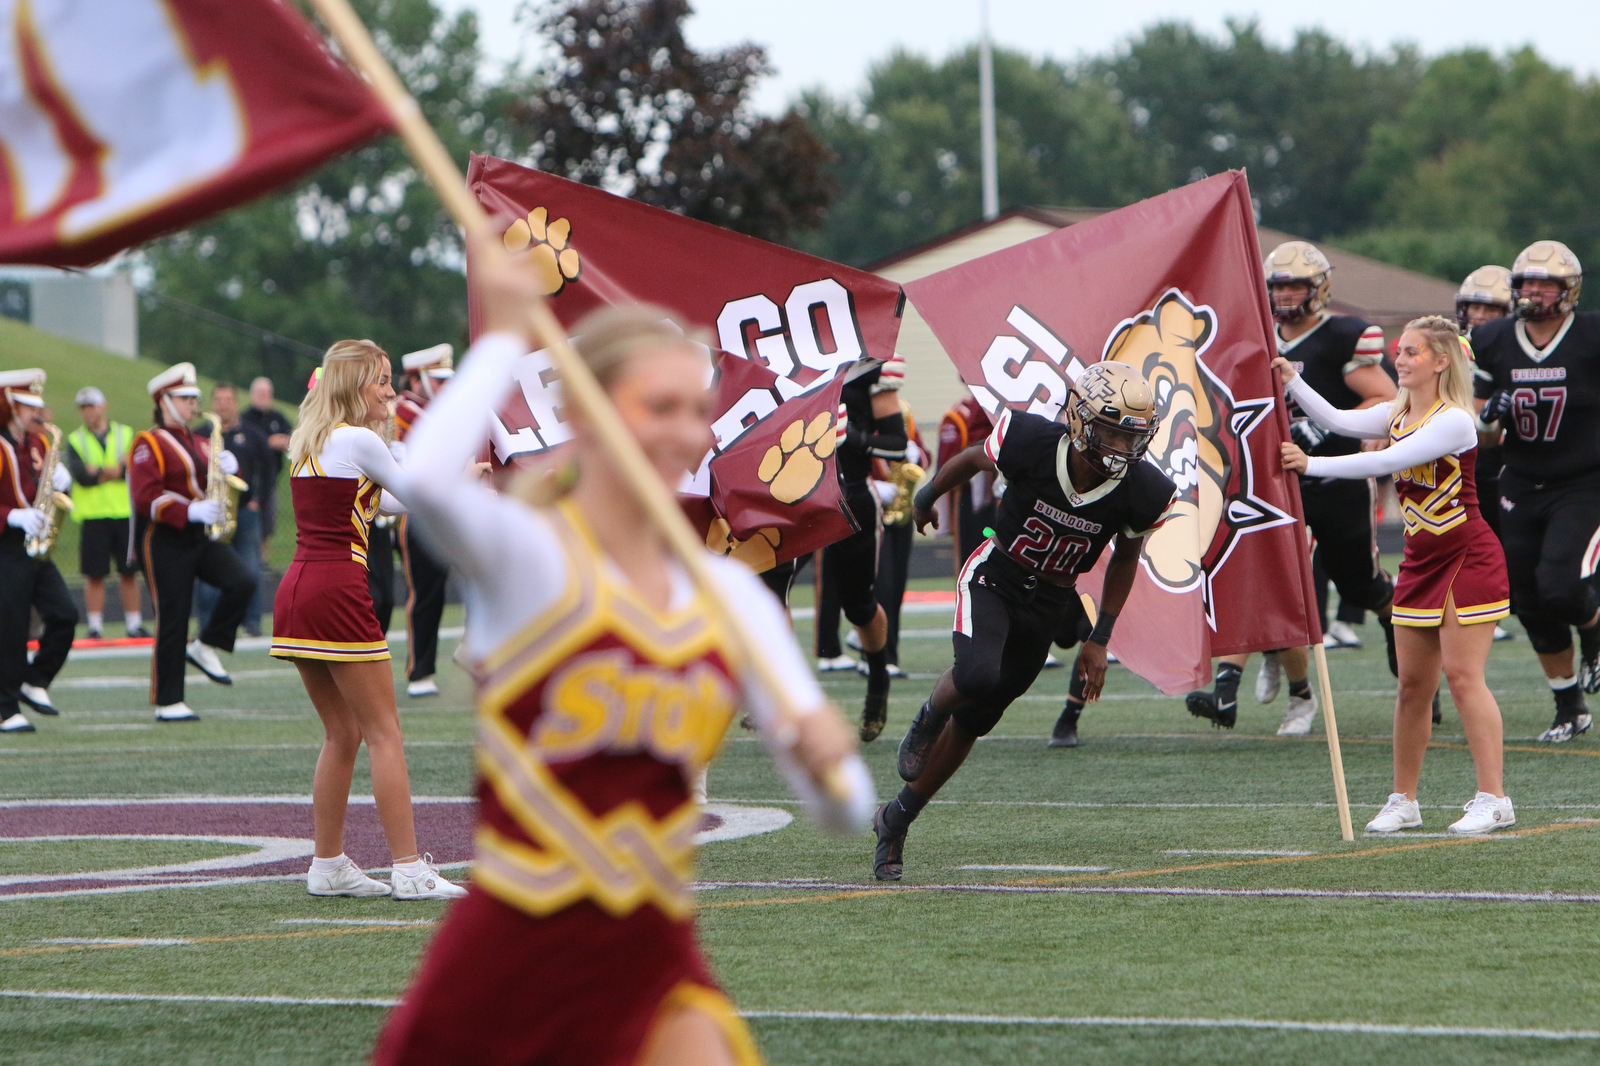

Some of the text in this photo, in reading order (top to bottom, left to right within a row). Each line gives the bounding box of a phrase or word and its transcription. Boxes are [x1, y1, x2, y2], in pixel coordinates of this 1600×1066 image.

[716, 277, 868, 377] GO
[1082, 366, 1116, 401] SMF
[1511, 367, 1567, 382] BULLDOGS
[1511, 386, 1567, 442] 67
[1033, 499, 1103, 534] BULLDOGS
[1008, 517, 1092, 574] 20
